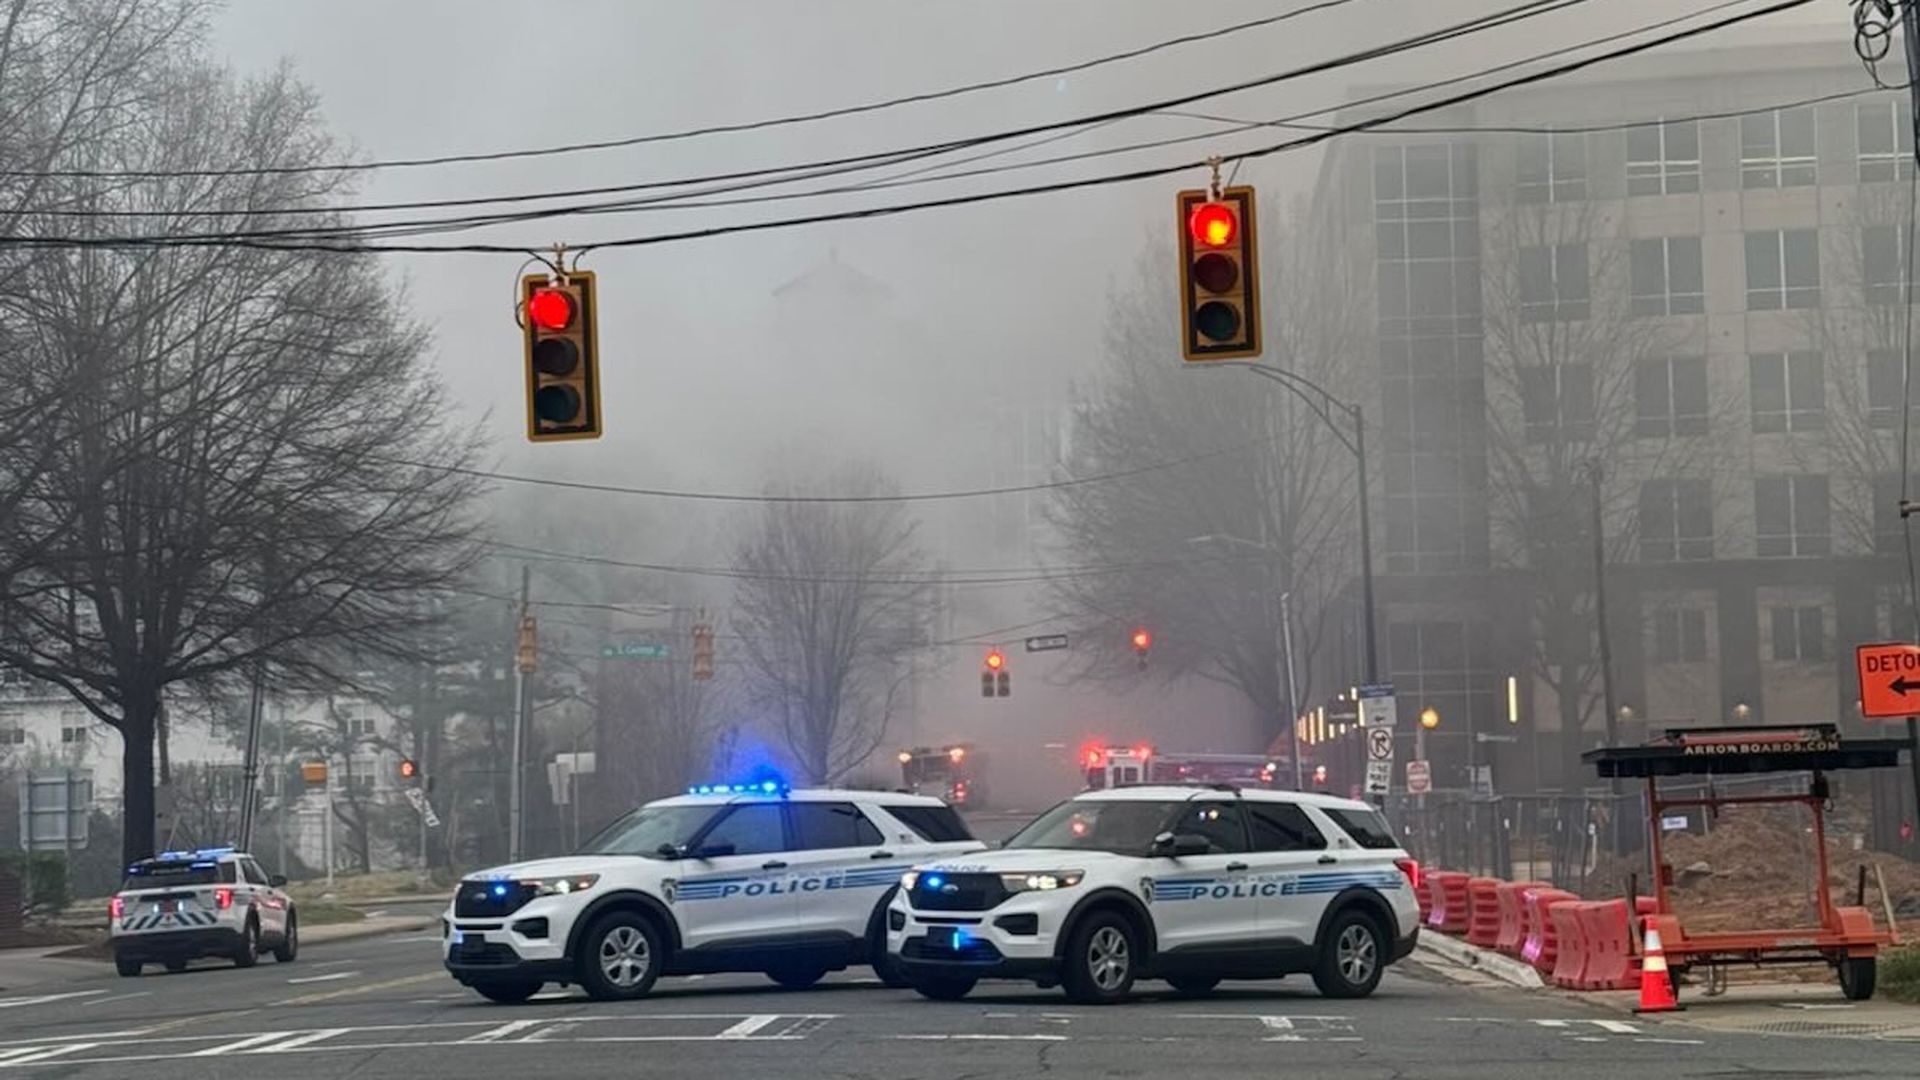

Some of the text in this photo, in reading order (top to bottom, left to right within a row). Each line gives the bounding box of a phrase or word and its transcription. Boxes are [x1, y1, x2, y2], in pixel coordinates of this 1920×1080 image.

[1866, 653, 1920, 673] DETO
[721, 877, 844, 897] POLICE
[1192, 883, 1296, 898] POLICE
